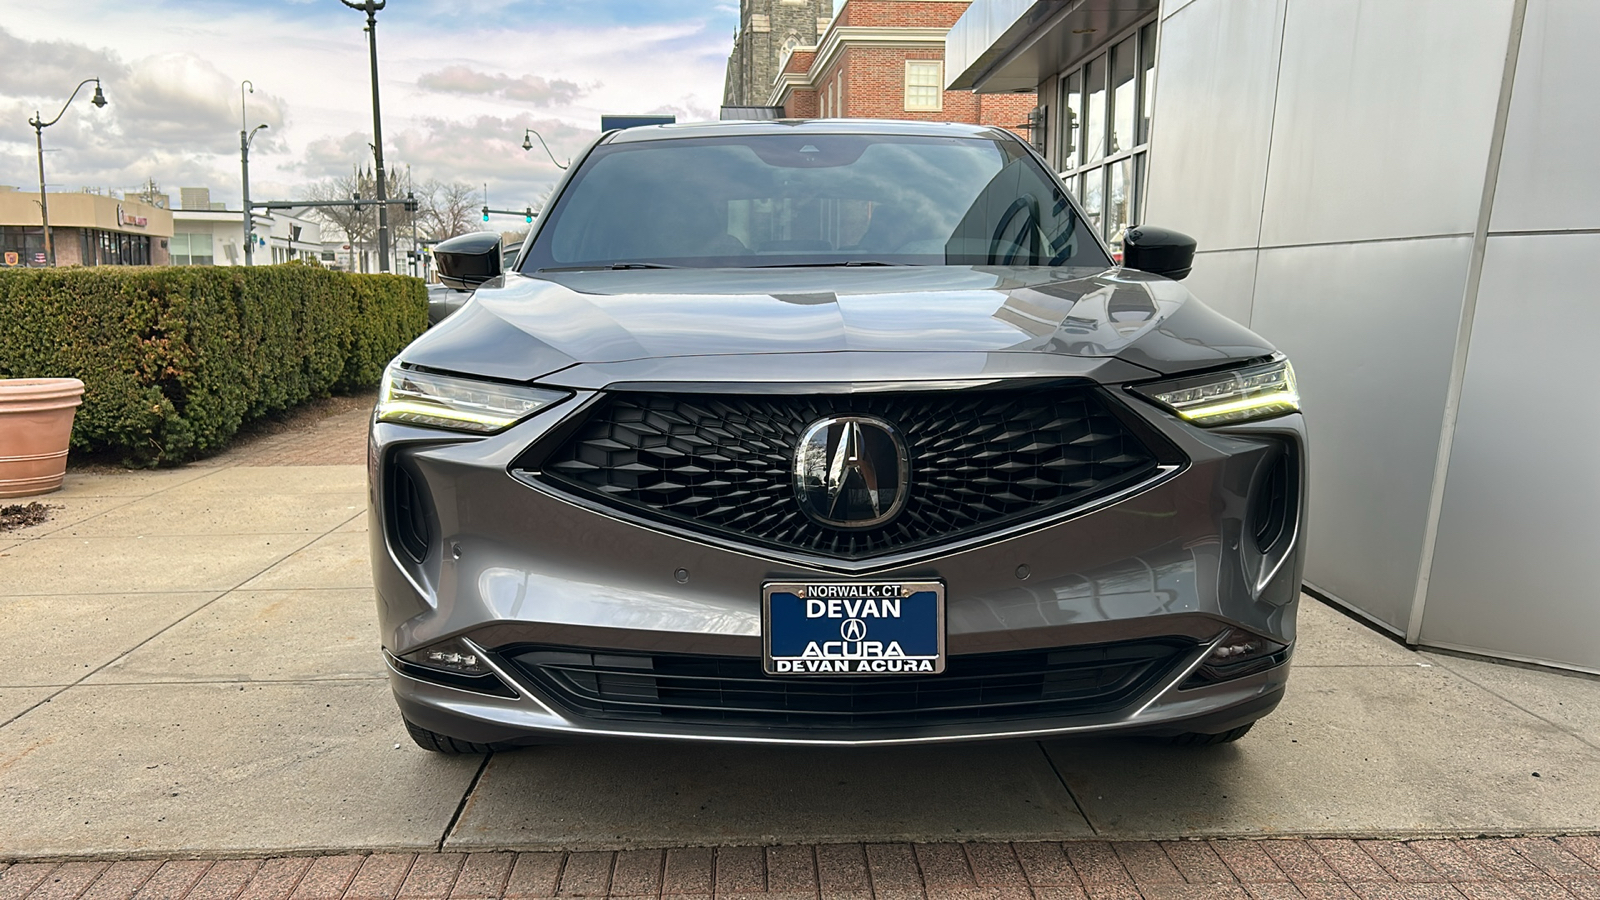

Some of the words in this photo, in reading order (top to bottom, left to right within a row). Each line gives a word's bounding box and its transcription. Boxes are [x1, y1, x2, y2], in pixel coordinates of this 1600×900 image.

[808, 586, 880, 597] NORWALK,
[882, 585, 900, 597] CT
[806, 599, 901, 618] DEVAN
[801, 641, 906, 658] ACURA
[777, 660, 849, 672] DEVAN
[857, 659, 933, 672] ACURA
